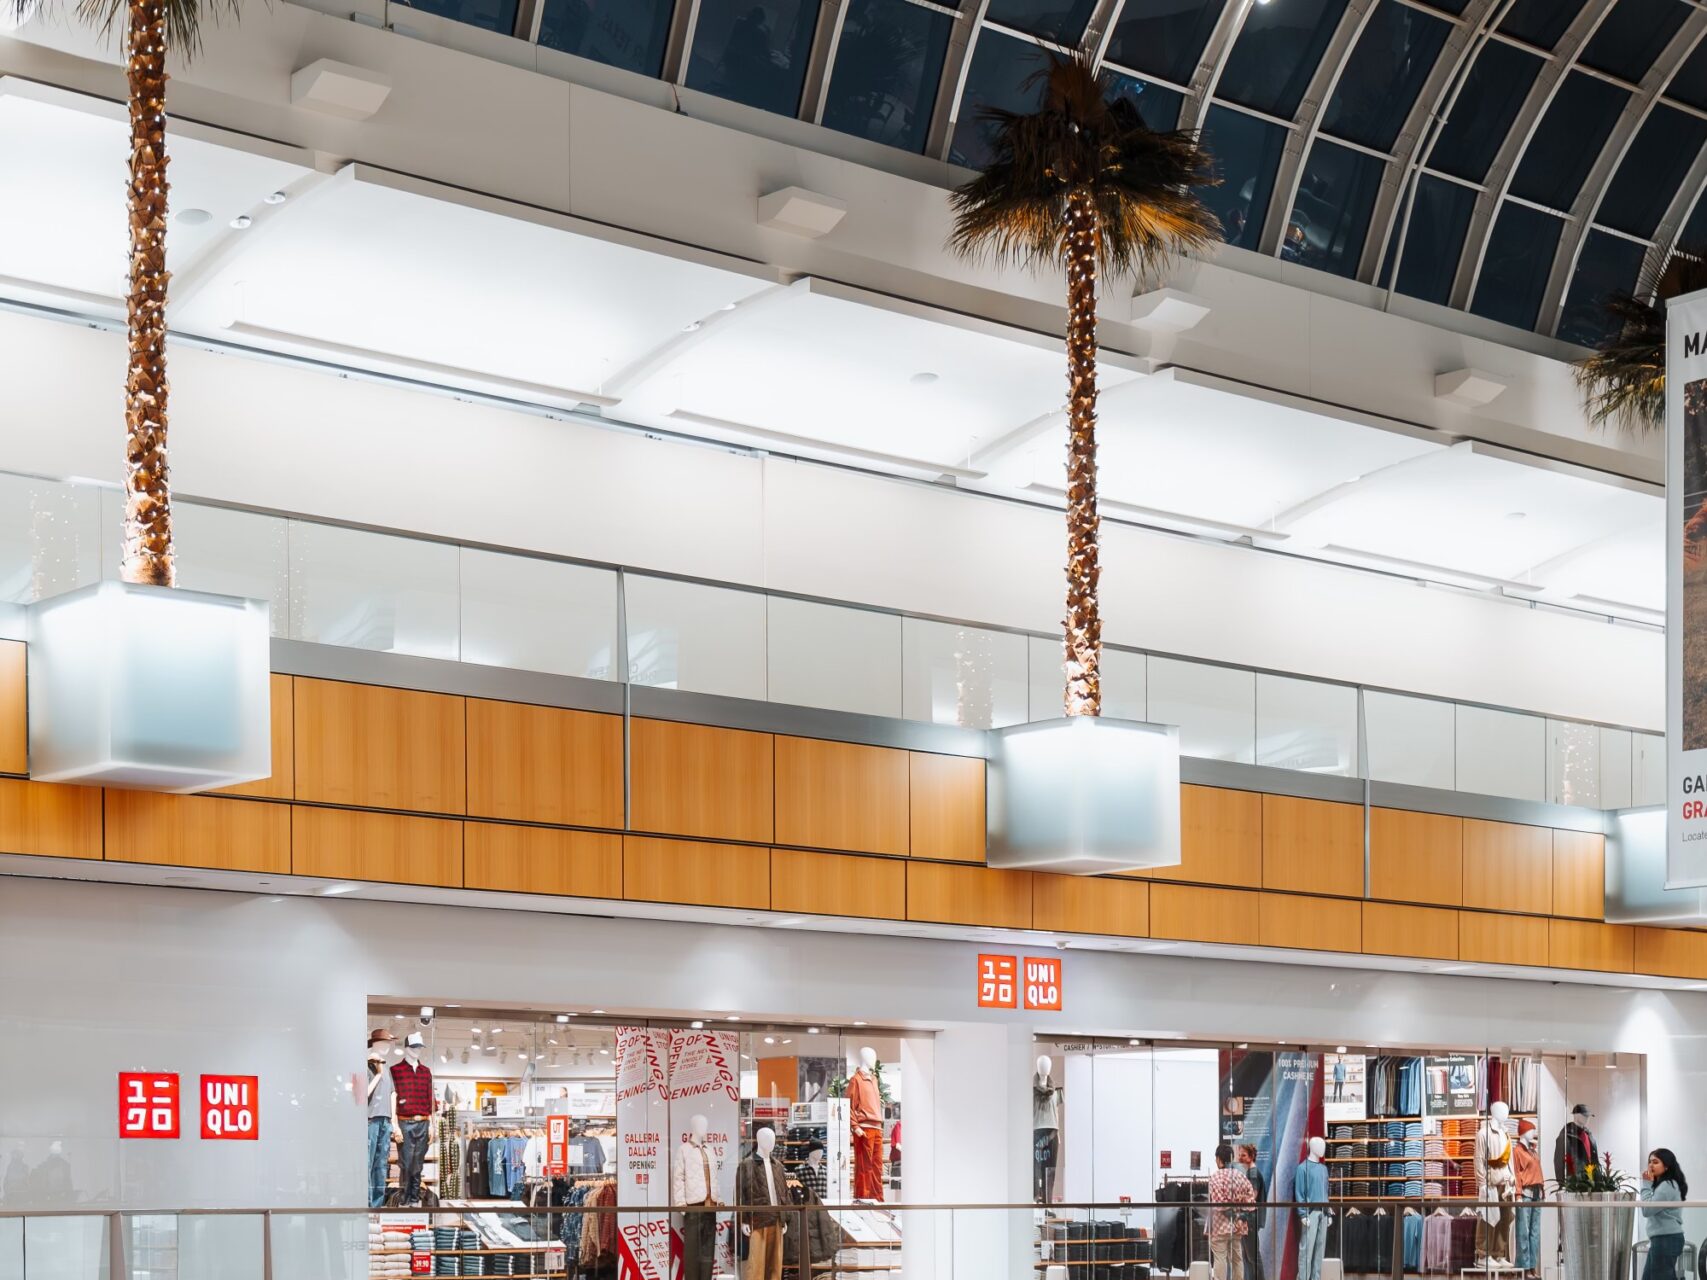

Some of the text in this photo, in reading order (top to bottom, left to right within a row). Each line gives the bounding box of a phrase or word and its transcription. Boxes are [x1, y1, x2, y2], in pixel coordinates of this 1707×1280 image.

[1682, 774, 1707, 794] GA
[1682, 800, 1707, 820] GR
[1027, 963, 1055, 983] UNI
[1027, 985, 1058, 1007] QLO
[207, 1082, 248, 1106] UNI
[207, 1108, 252, 1135] QLO
[624, 1132, 660, 1144] GALLERIA
[681, 1132, 728, 1143] GERIA
[628, 1146, 657, 1157] DALLAS
